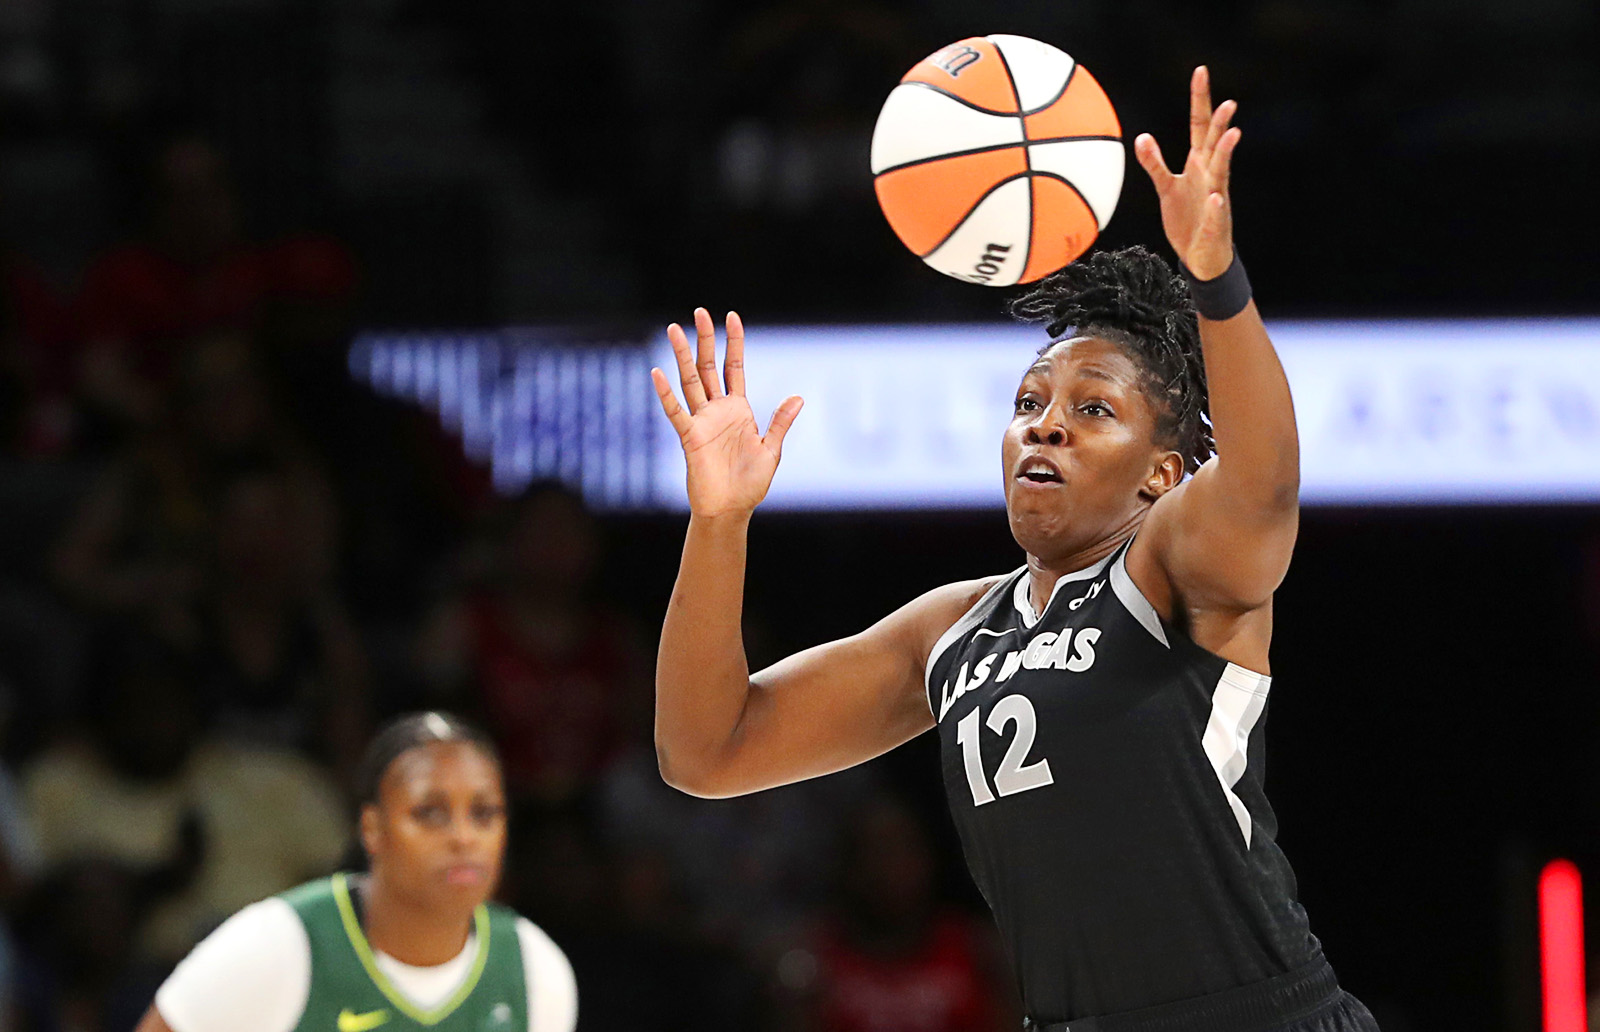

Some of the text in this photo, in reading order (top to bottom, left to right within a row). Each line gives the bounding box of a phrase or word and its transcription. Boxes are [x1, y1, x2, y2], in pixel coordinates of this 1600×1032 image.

[938, 627, 1102, 724] LAS VGAS
[956, 693, 1055, 807] 12
